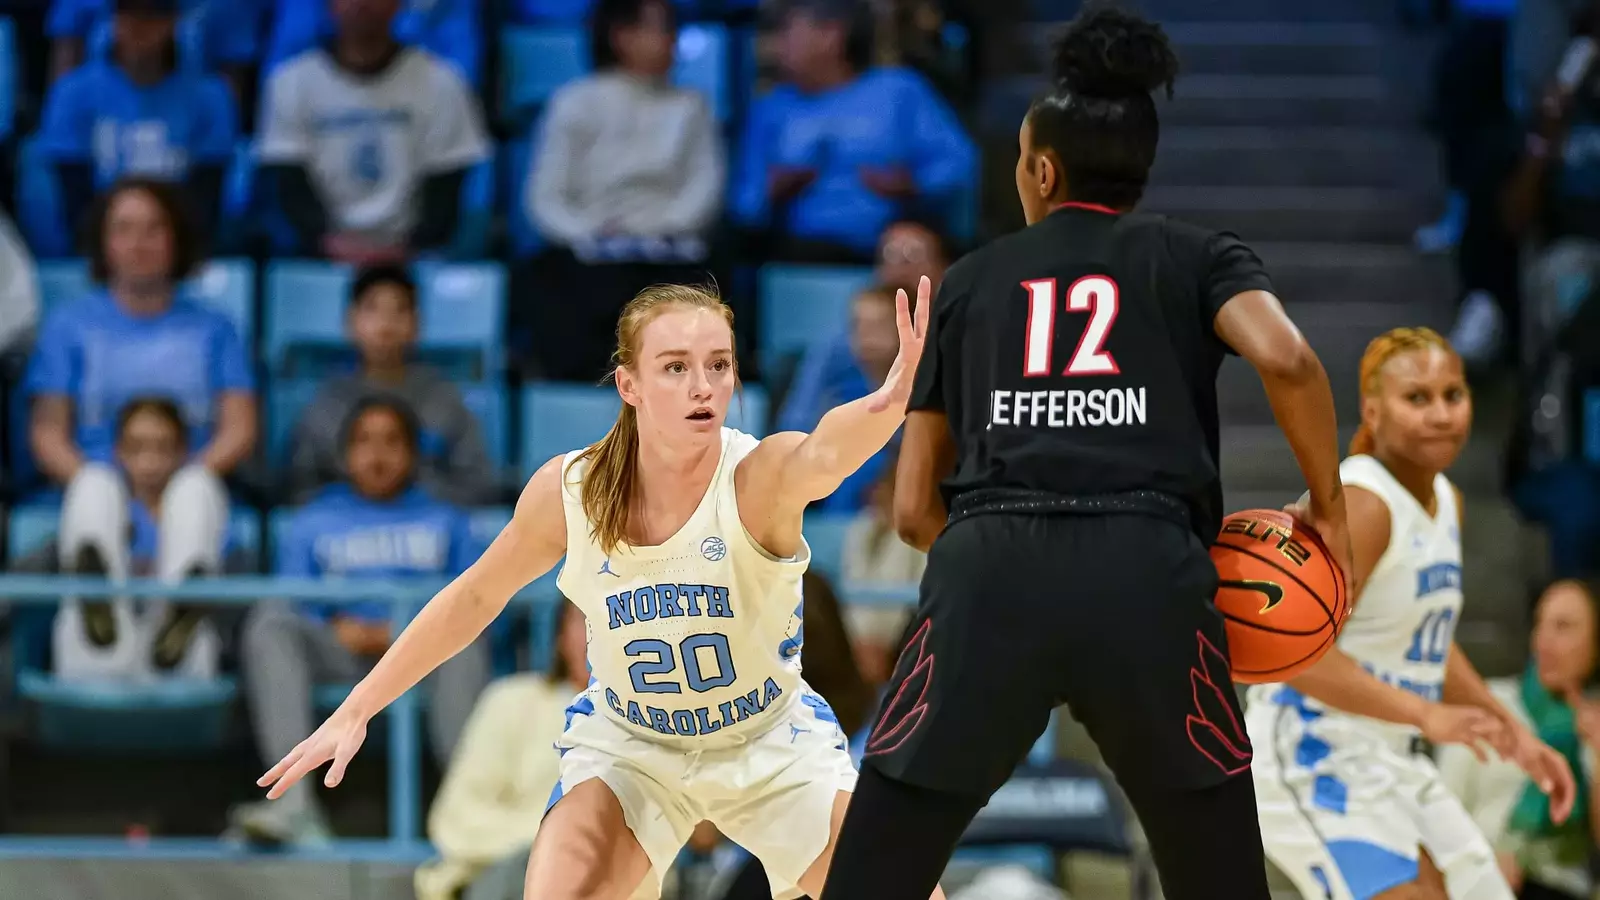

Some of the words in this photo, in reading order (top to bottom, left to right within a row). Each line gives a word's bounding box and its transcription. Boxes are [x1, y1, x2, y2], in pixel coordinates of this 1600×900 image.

[1020, 274, 1121, 378] 12
[986, 386, 1147, 431] EFFERSON
[1222, 518, 1312, 567] ELITE
[605, 583, 735, 630] NORTH
[623, 632, 737, 694] 20
[605, 676, 783, 737] CAROLINA
